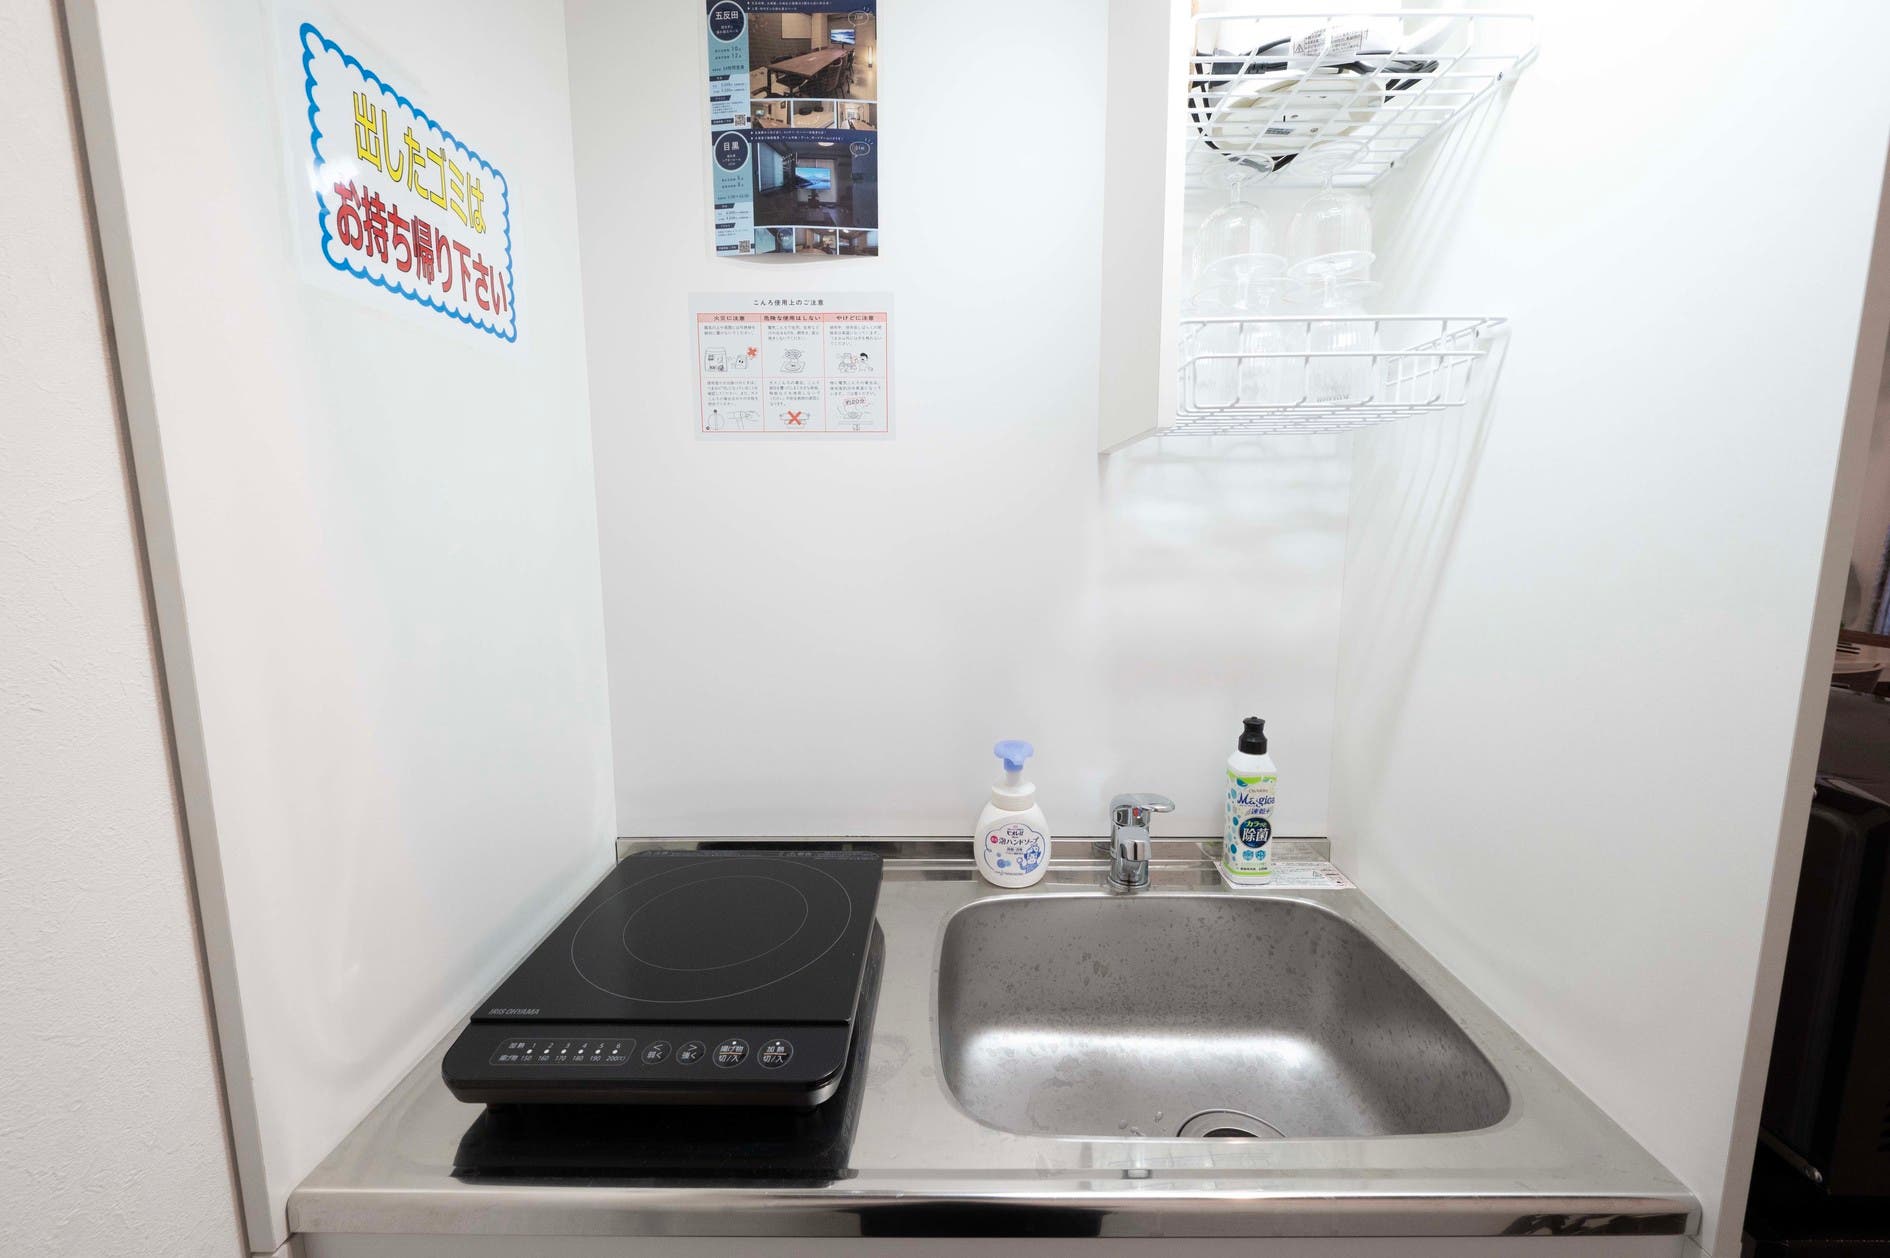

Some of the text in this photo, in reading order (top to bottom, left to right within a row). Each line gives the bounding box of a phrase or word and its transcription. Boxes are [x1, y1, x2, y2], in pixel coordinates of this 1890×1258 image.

[715, 10, 739, 20] 五反田
[723, 141, 740, 151] 目黒
[352, 91, 486, 233] 出したゴミは
[333, 180, 508, 315] お持ち帰り下さい
[1242, 828, 1270, 842] 除菌
[999, 836, 1039, 846] 泡ハンドソープ
[718, 1055, 739, 1063] 切/入
[763, 1055, 784, 1063] 切/入
